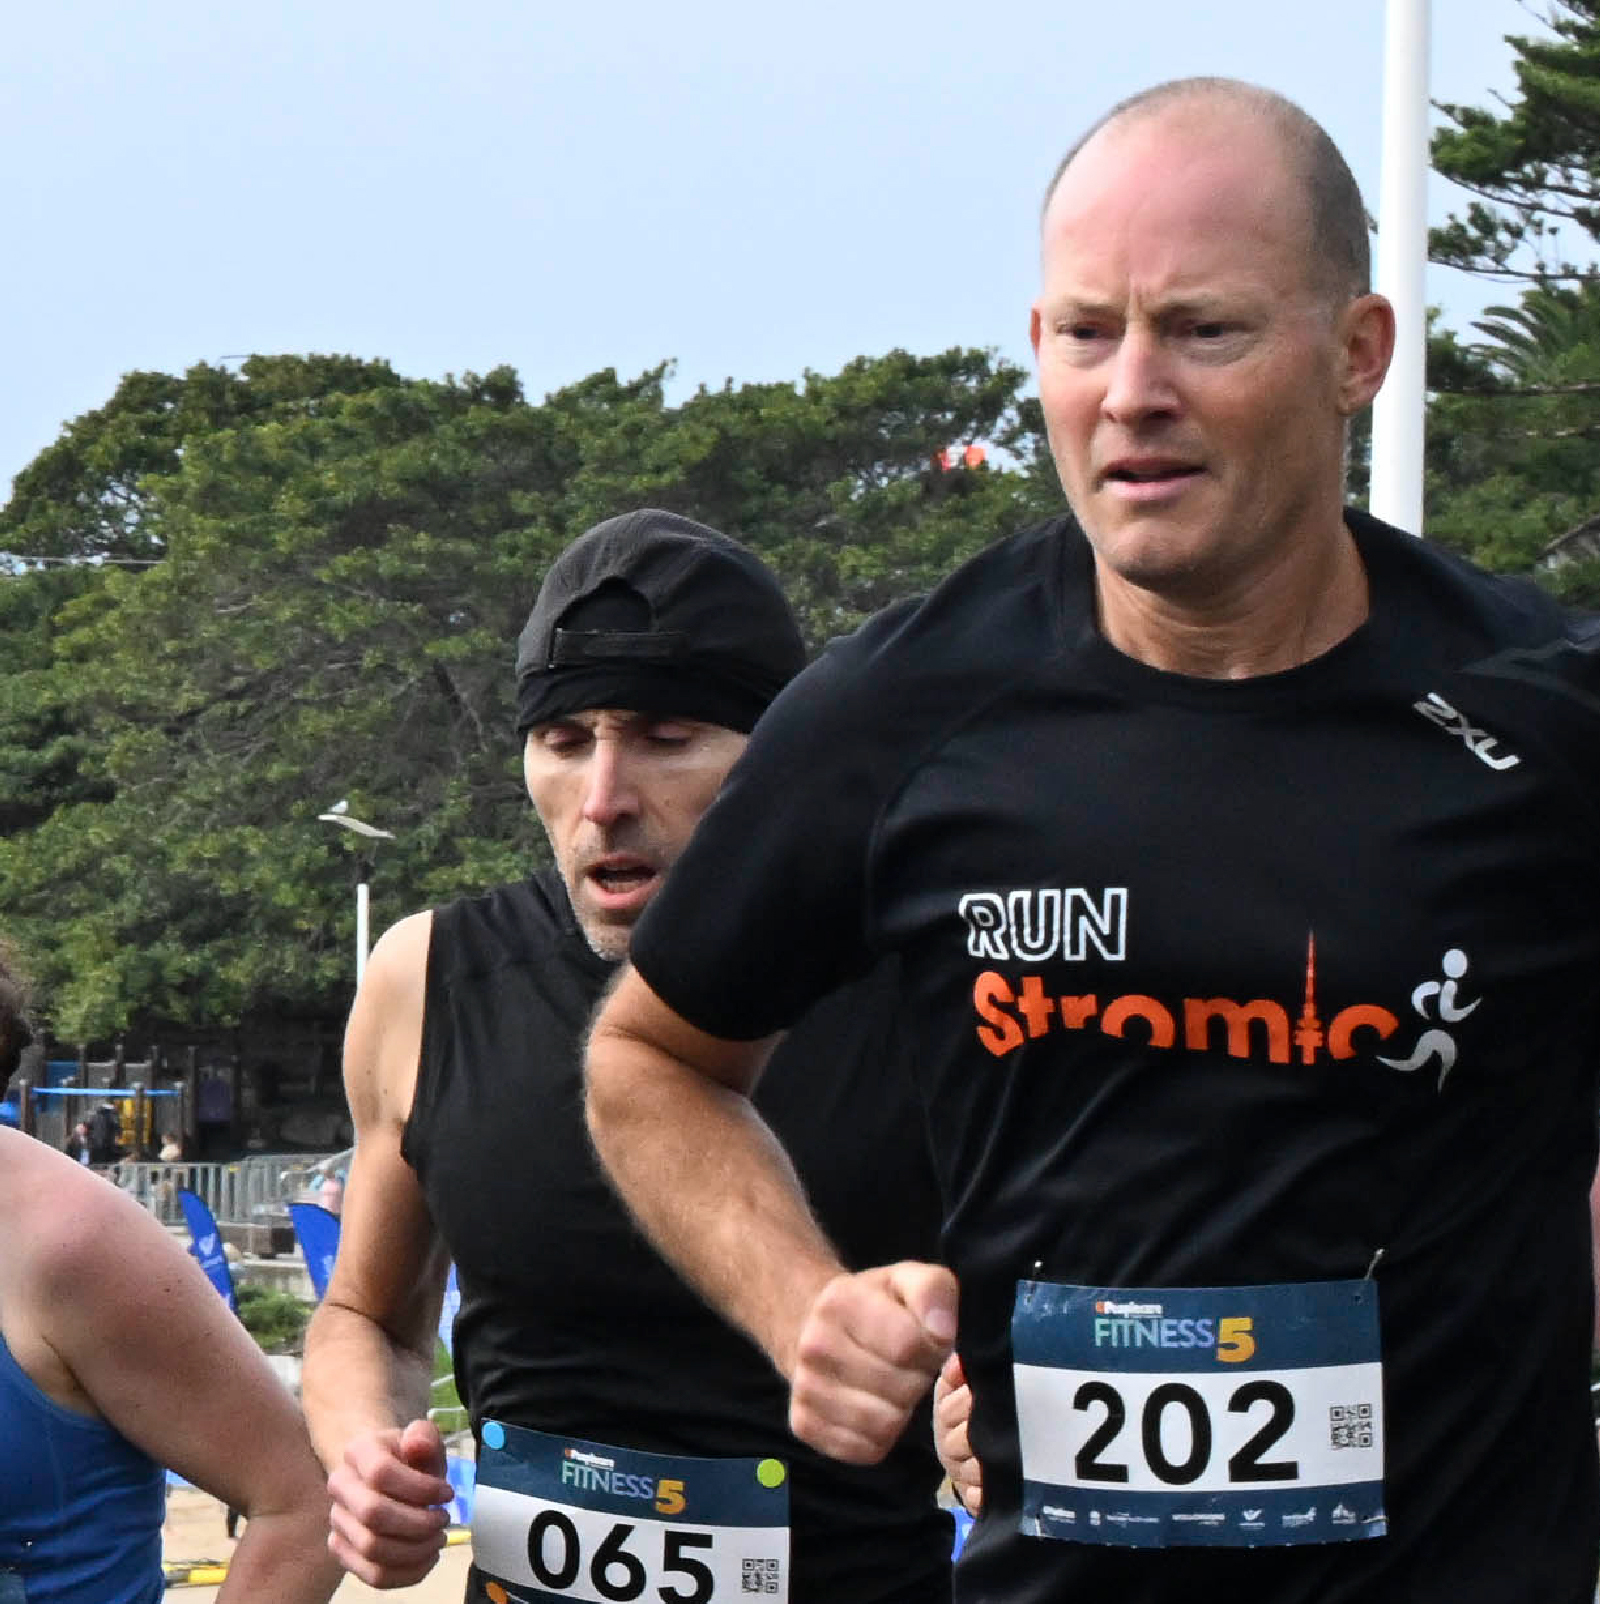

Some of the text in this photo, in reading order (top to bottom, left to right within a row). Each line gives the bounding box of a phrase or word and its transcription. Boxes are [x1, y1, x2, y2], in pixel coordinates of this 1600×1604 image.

[1413, 692, 1520, 770] 2XU
[959, 887, 1128, 962] RUN
[1095, 1317, 1255, 1363] FITNESS 5
[1073, 1379, 1300, 1486] 202
[562, 1459, 653, 1499] FITNESS
[655, 1479, 687, 1515] 5
[527, 1510, 715, 1604] 065
